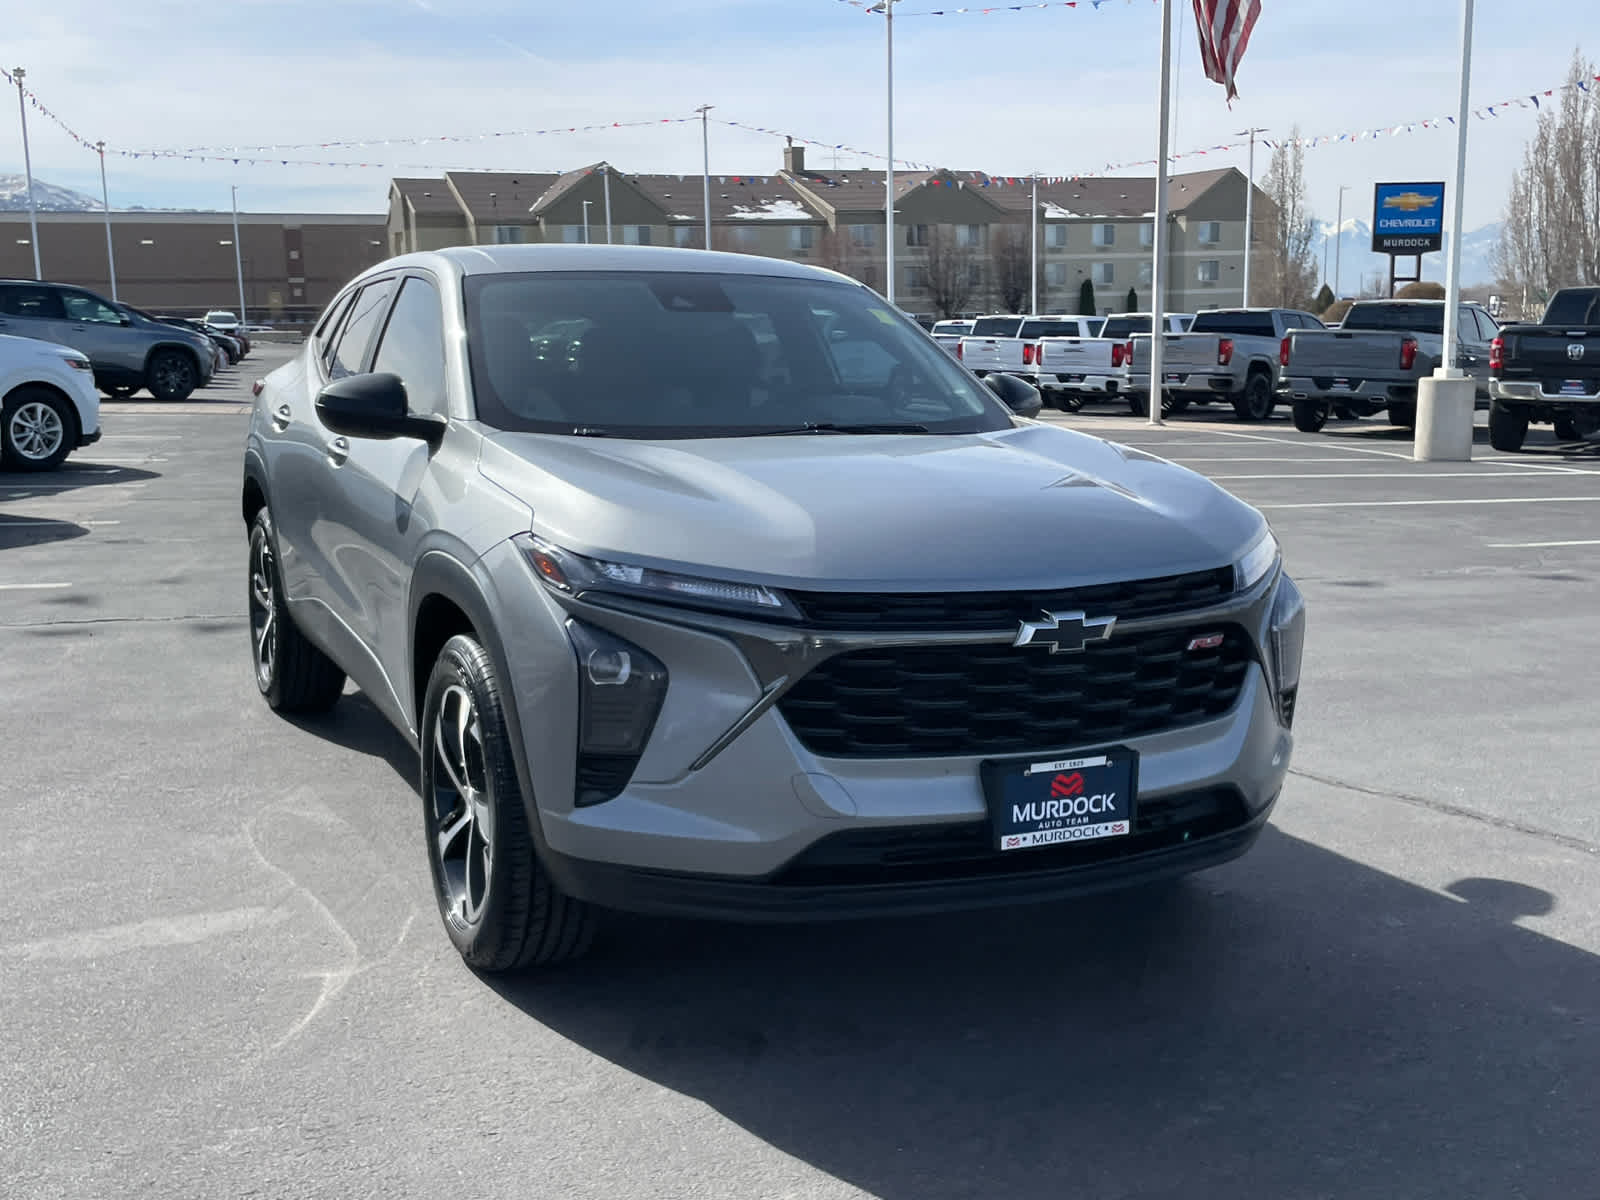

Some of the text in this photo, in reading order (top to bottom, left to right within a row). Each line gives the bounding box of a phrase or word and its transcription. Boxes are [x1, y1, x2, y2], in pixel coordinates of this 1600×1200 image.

[1379, 218, 1437, 228] CHEVROLET
[1384, 239, 1431, 247] MURDOCK
[1012, 792, 1116, 823] MURDOCK
[1038, 816, 1089, 829] AUTO TEAM
[1032, 825, 1102, 844] MURDOCK
